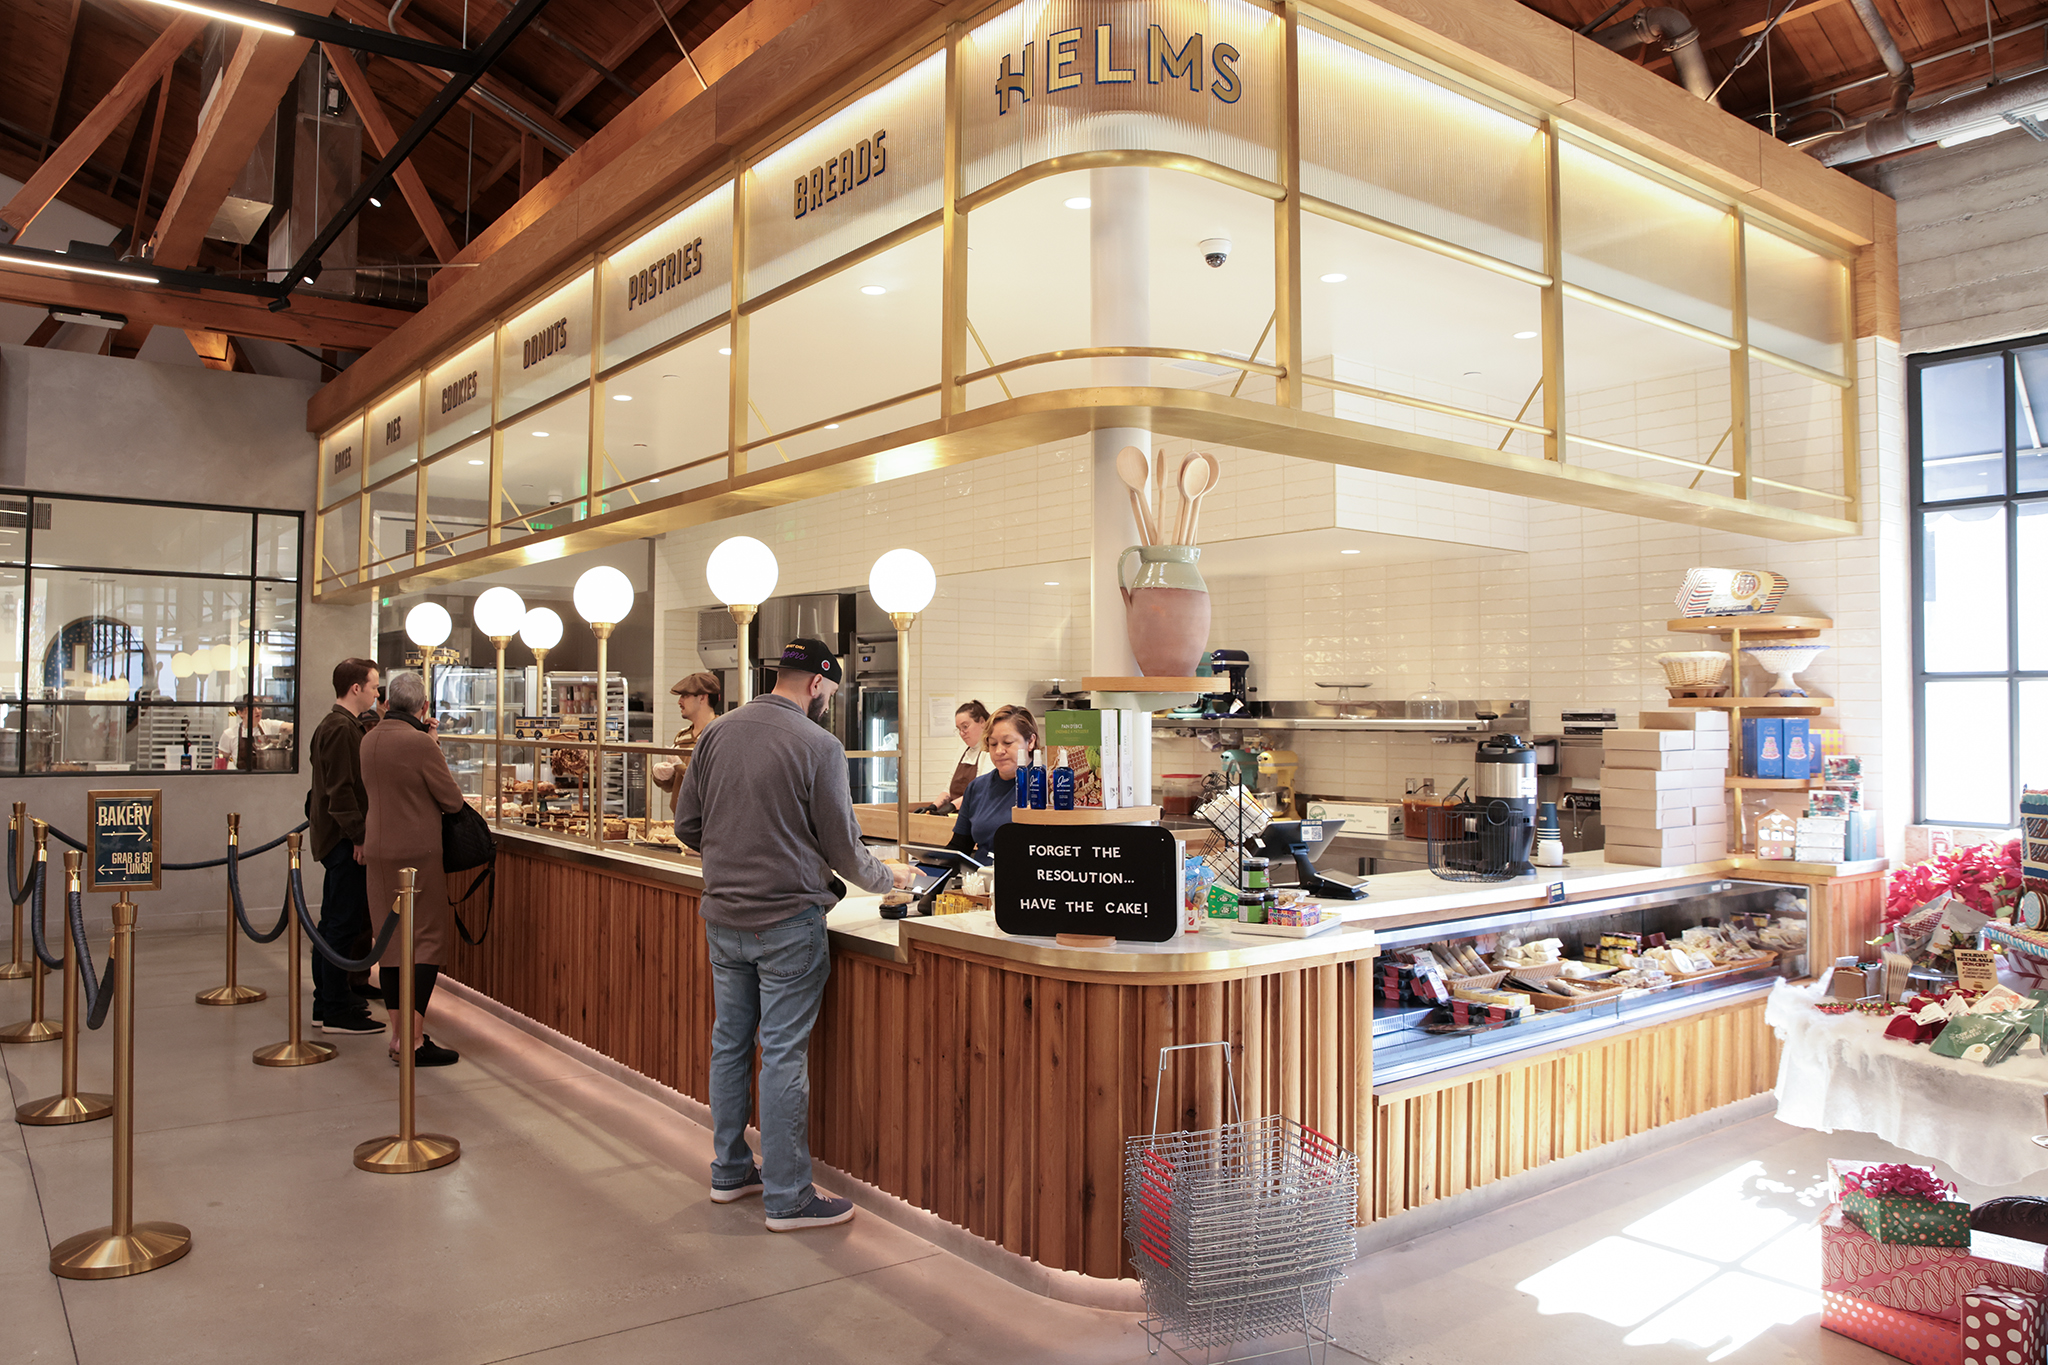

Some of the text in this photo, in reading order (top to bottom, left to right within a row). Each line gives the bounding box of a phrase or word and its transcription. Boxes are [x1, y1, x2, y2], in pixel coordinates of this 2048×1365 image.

[996, 23, 1242, 116] HELMS
[794, 128, 886, 220] BREADS
[628, 236, 702, 311] PASTRIES
[523, 317, 567, 370] DONUTS
[441, 370, 478, 414] COOKIES
[386, 415, 401, 446] PIES
[334, 446, 352, 475] CAKES
[98, 805, 152, 826] BAKERY
[112, 852, 153, 864] GRAB & GO
[1029, 845, 1121, 858] FORGET THE
[126, 863, 150, 874] LUNCH
[1037, 869, 1135, 884] RESOLUTION...
[1020, 898, 1148, 918] HAVE THE CAKE!
